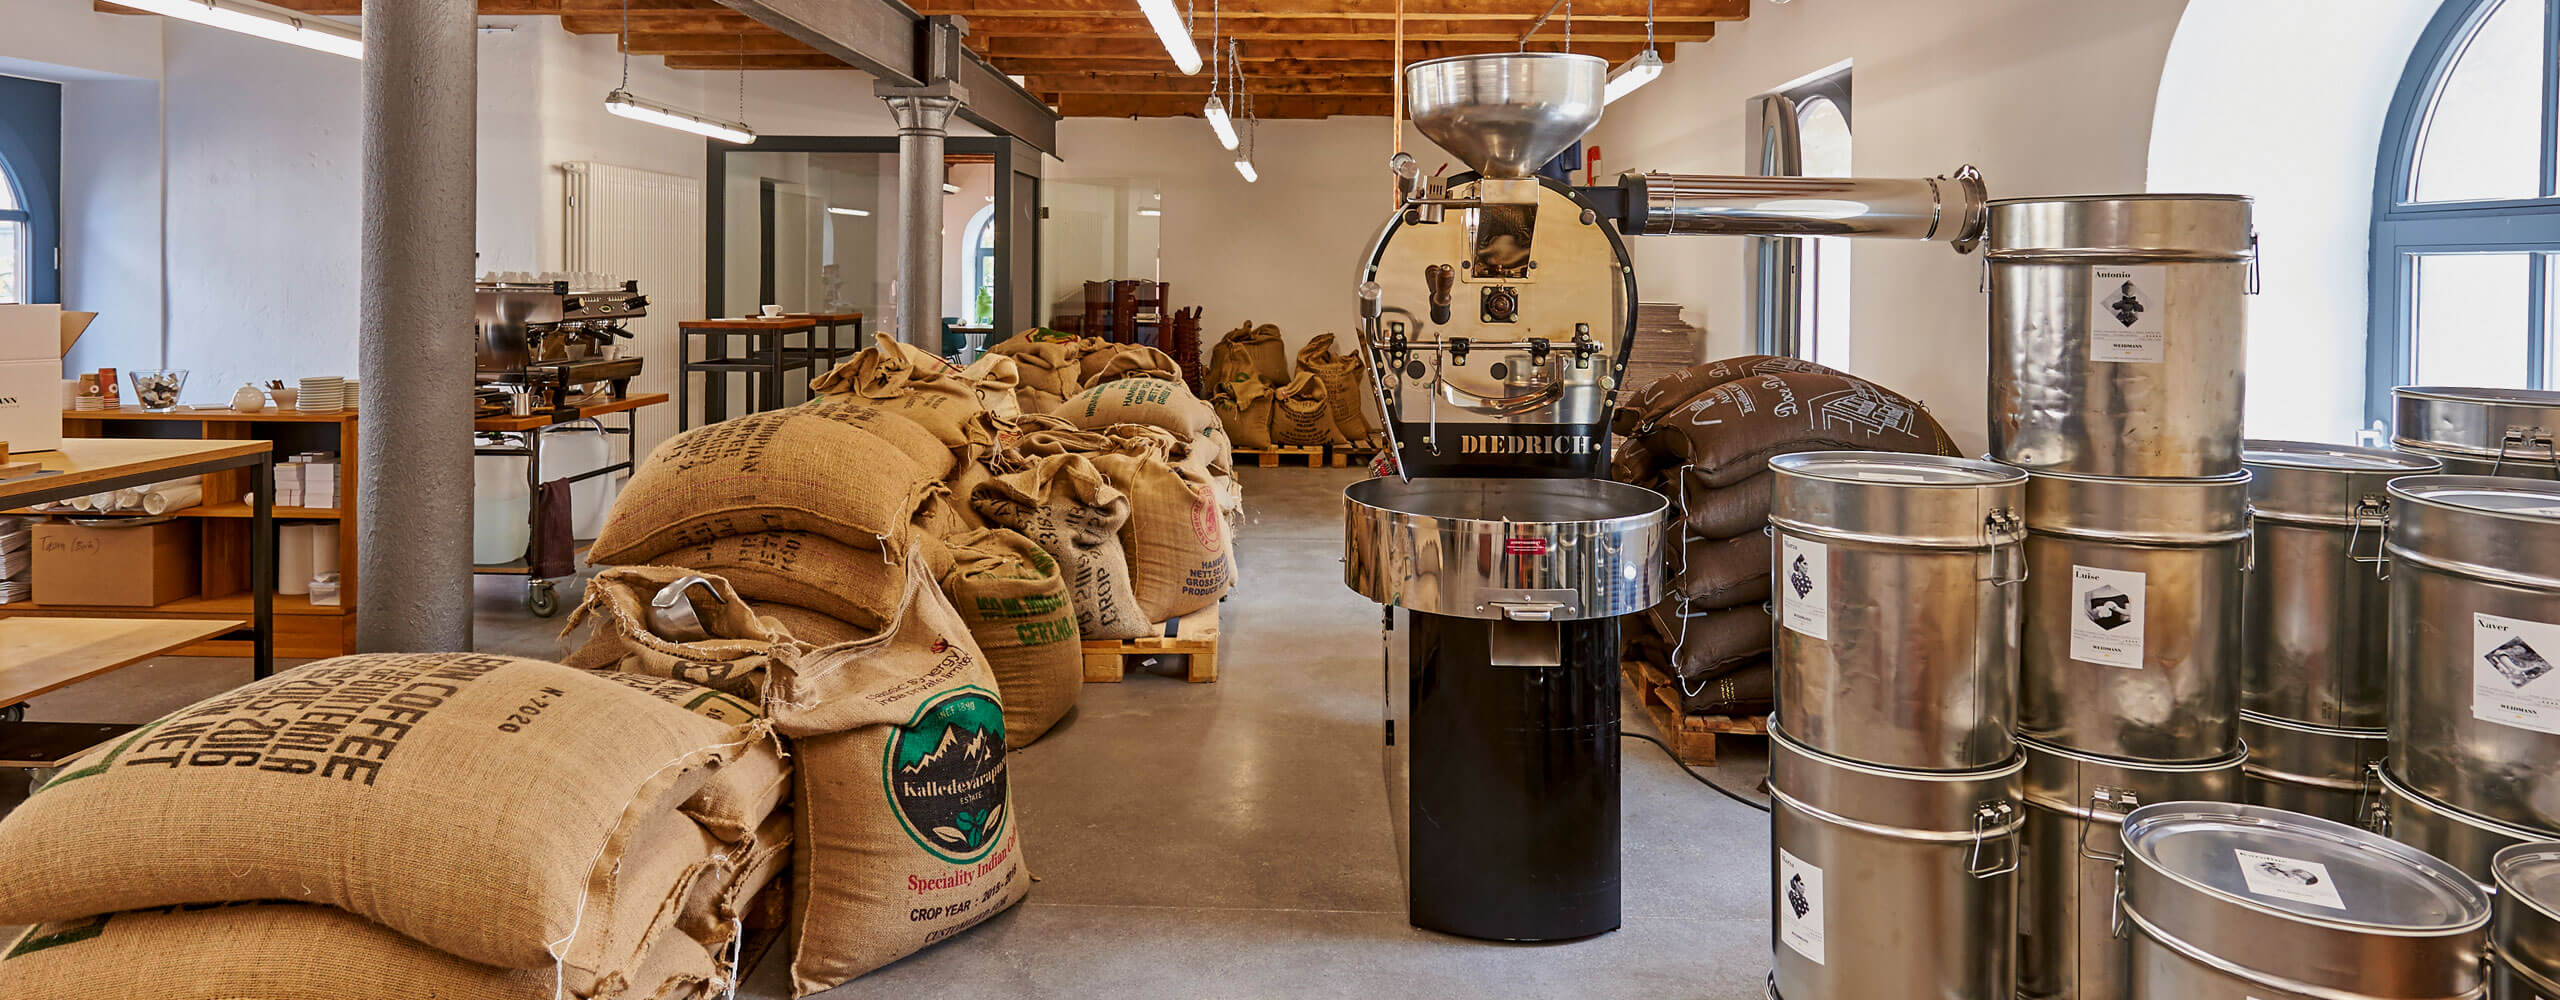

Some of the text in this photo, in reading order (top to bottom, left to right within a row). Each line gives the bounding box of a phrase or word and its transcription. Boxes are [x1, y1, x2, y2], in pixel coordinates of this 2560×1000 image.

[2095, 271, 2131, 279] Antonio
[1461, 435, 1592, 455] DIEDRICH
[1185, 577, 1213, 588] GROSS
[2075, 571, 2100, 581] Luise
[188, 679, 345, 768] 2015-2016
[259, 680, 401, 775] GUATEMALA
[321, 682, 459, 788] COFFEE
[960, 791, 983, 805] ESTATE
[907, 869, 976, 894] Speciality
[977, 848, 1007, 878] Indian
[910, 907, 942, 922] CROP
[945, 899, 971, 918] YEAR
